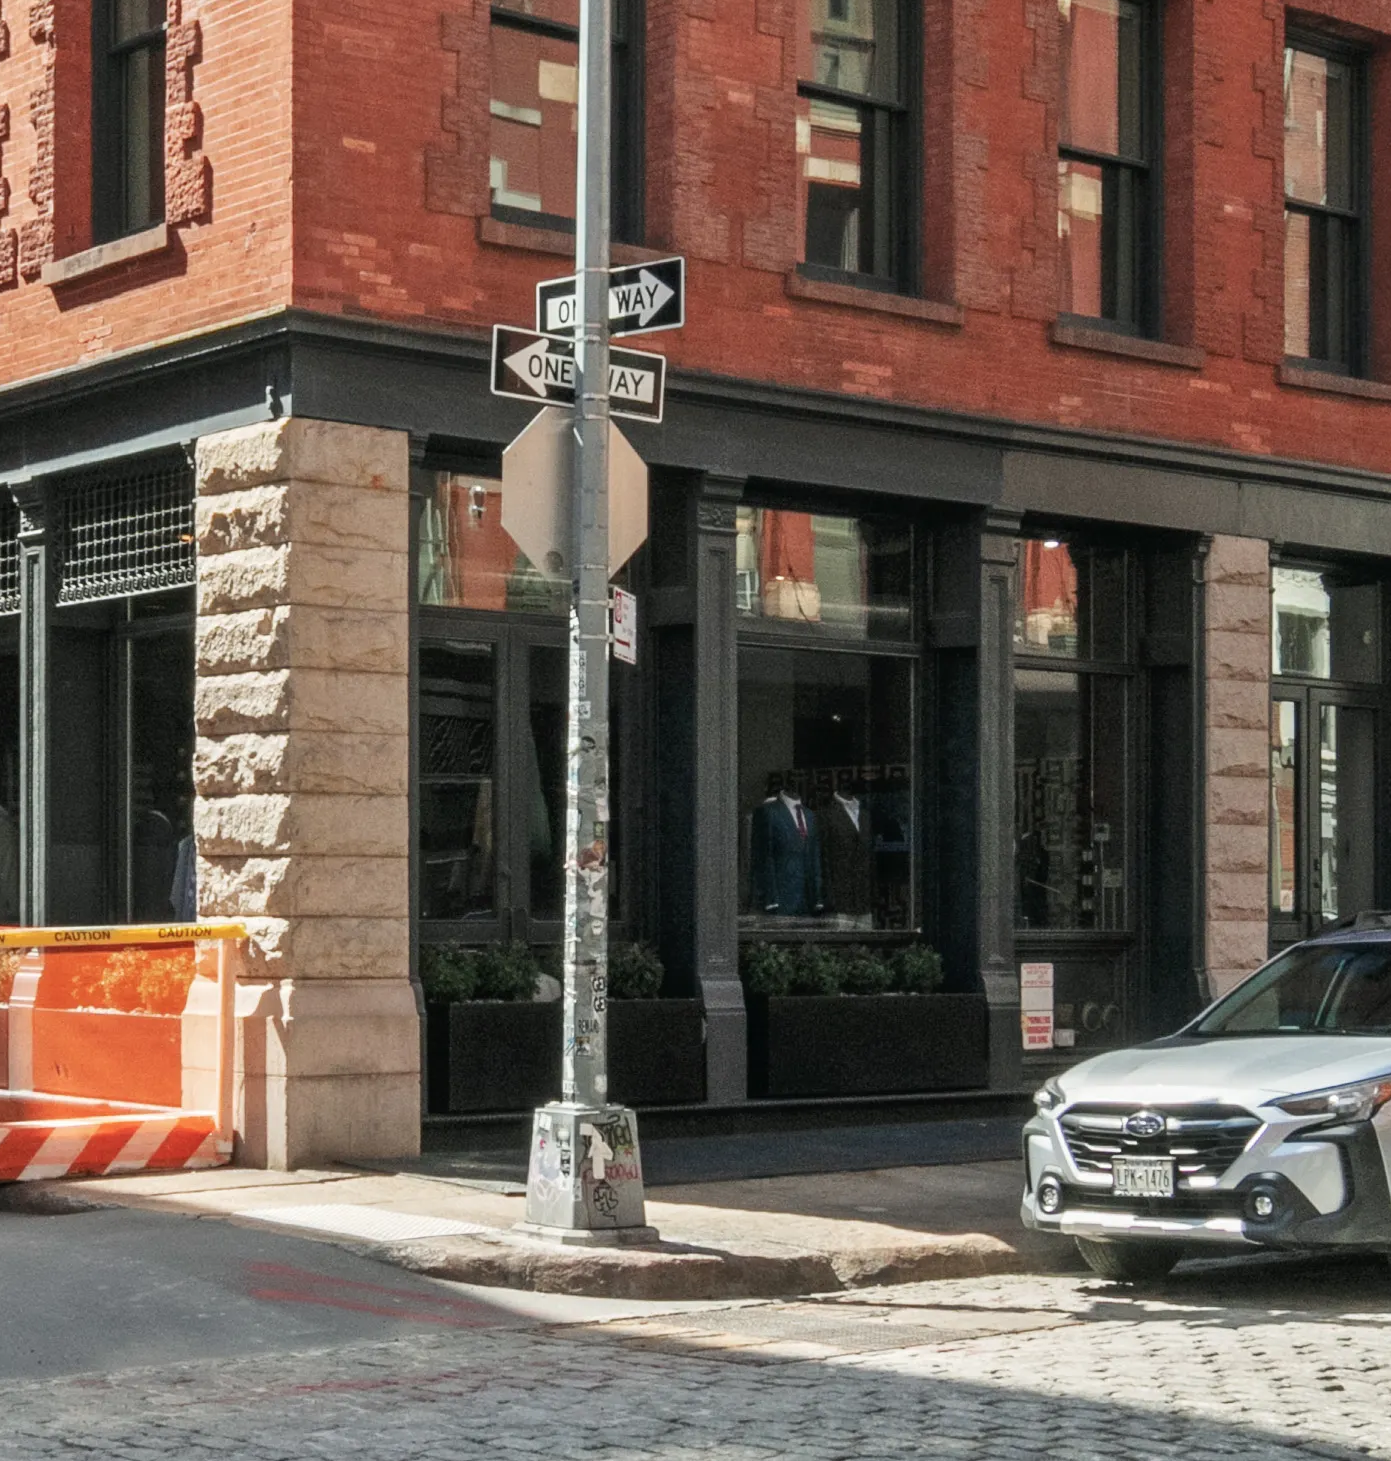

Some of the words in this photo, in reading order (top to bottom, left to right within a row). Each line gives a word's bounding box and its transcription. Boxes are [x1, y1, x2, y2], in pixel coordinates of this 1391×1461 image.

[616, 283, 658, 314] WAY
[529, 354, 573, 384] ONE
[54, 931, 111, 942] CAUTION
[158, 927, 212, 939] CAUTION
